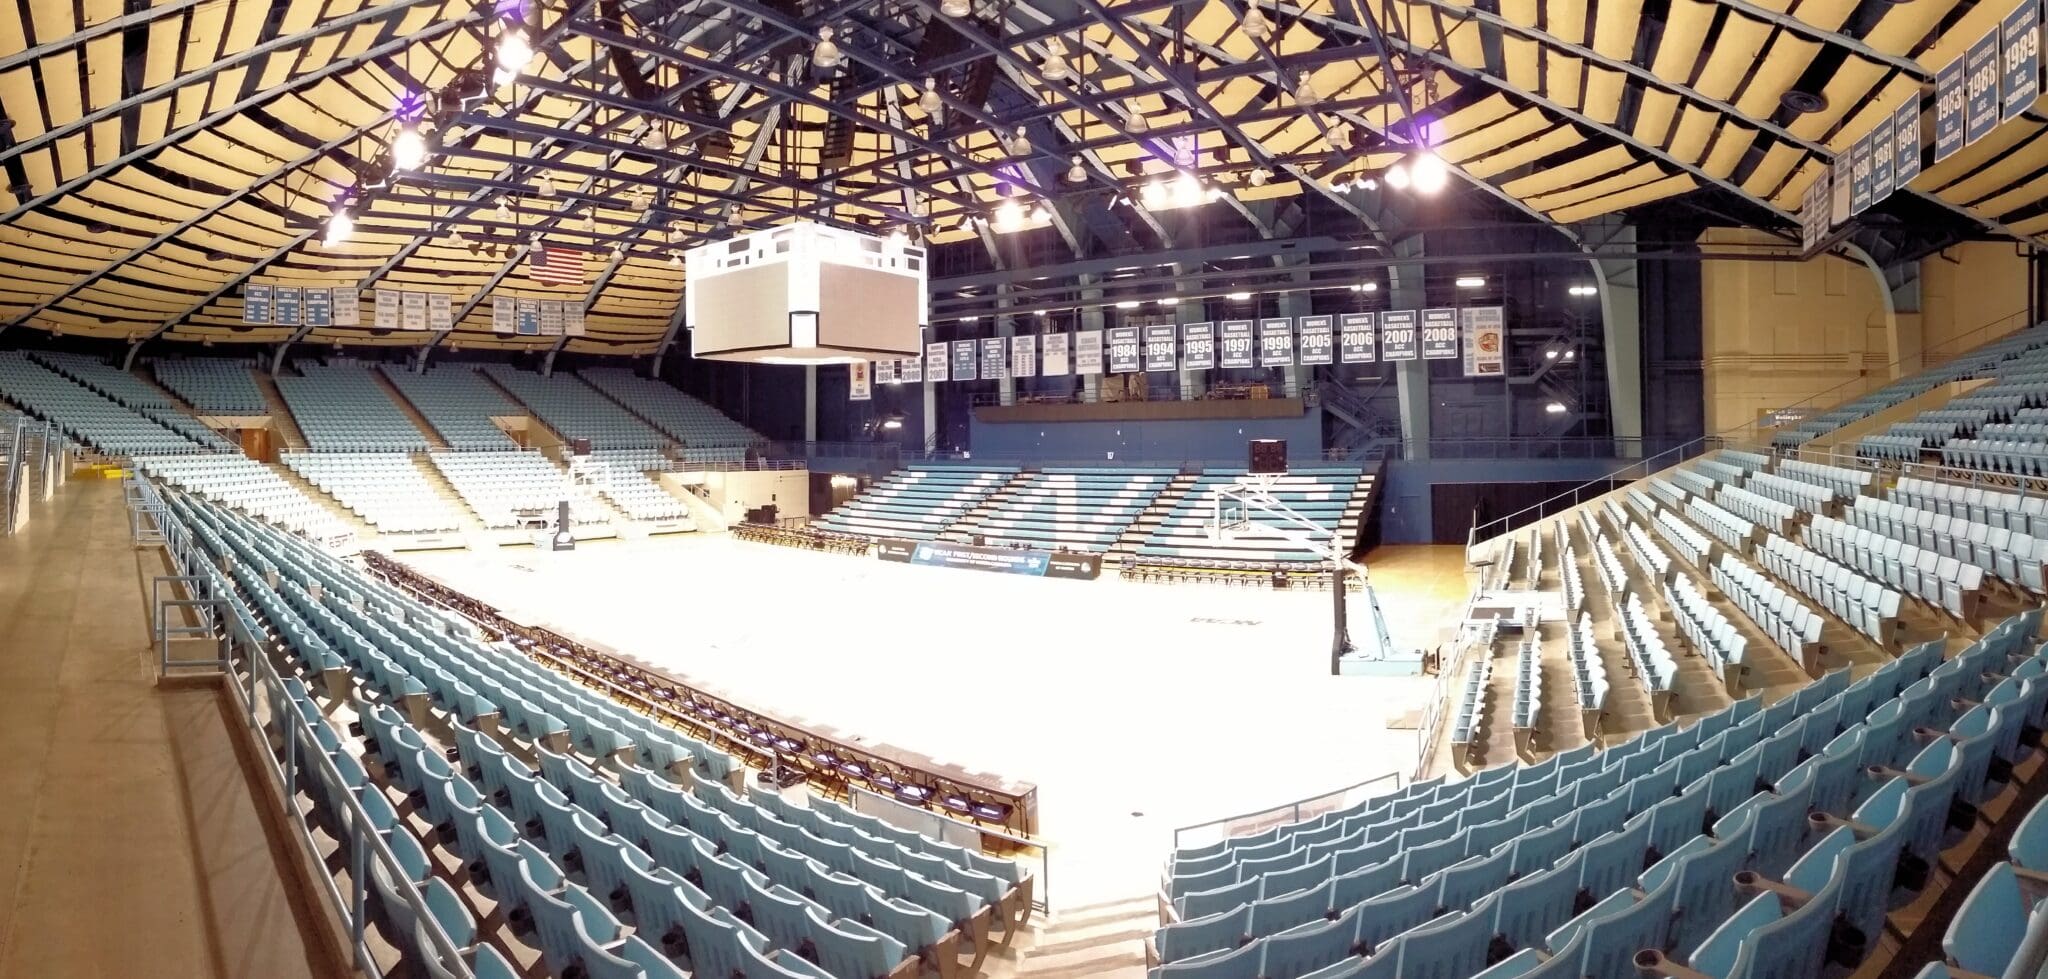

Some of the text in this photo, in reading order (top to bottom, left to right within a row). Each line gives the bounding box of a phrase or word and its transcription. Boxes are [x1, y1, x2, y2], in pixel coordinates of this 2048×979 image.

[2005, 27, 2038, 74] 1989
[1937, 86, 1961, 121] 1983
[1303, 335, 1330, 347] 2005
[1344, 332, 1372, 345] 2006
[1385, 330, 1413, 343] 2007
[1425, 328, 1454, 341] 2008
[1149, 343, 1173, 355] 1994
[1186, 341, 1212, 353] 1995
[1224, 339, 1250, 352] 1997
[1263, 337, 1290, 350] 1998
[1113, 345, 1136, 357] 1984
